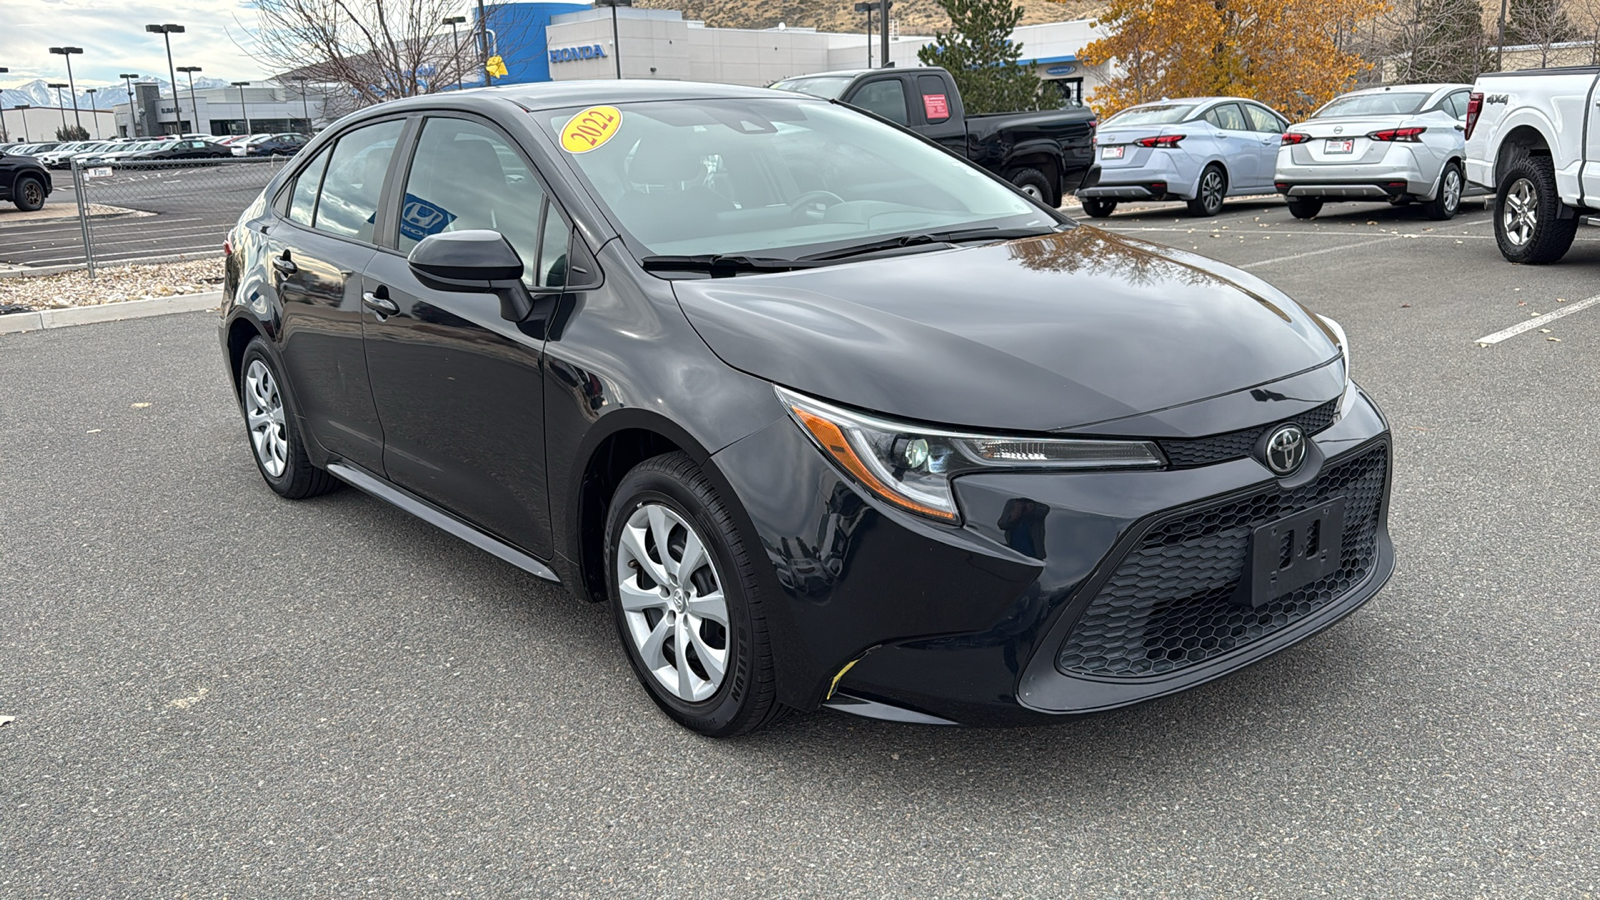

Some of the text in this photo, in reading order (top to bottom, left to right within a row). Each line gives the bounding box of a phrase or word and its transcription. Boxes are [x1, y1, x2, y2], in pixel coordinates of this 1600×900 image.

[549, 44, 607, 63] HONDA
[570, 111, 614, 146] 2022
[731, 626, 748, 702] SAILUN
